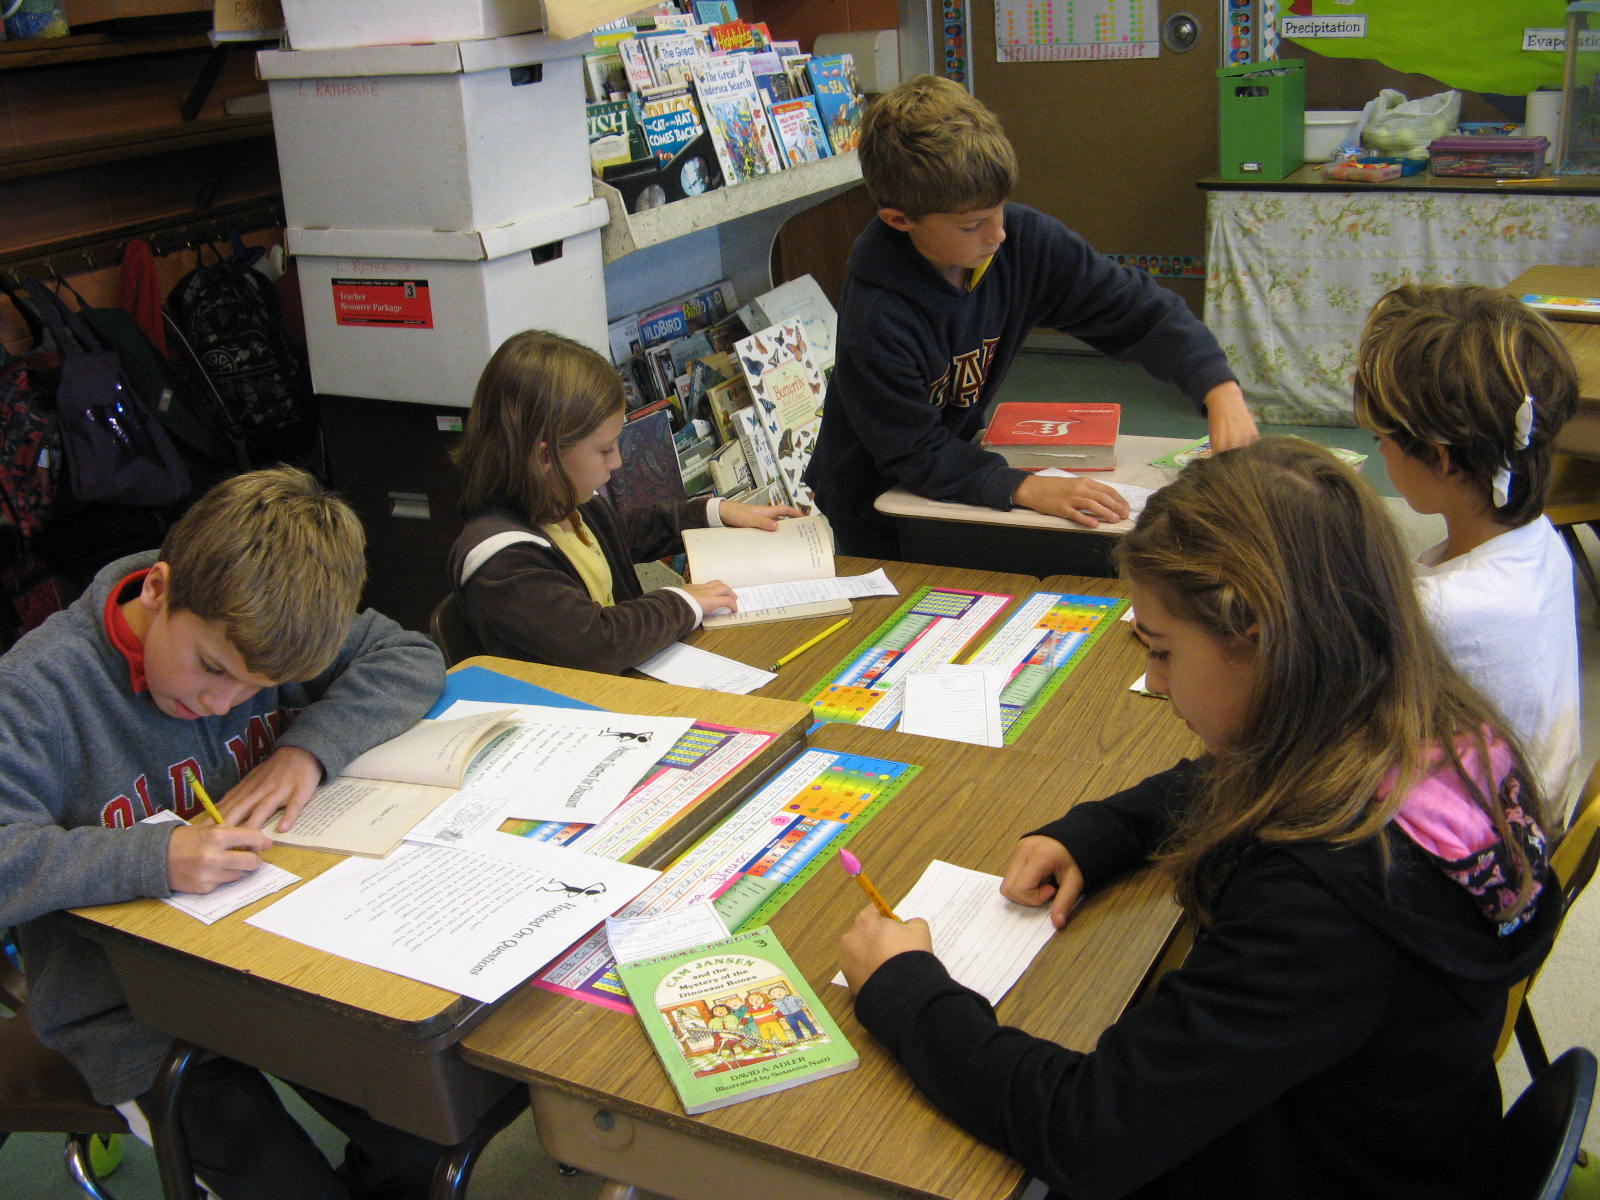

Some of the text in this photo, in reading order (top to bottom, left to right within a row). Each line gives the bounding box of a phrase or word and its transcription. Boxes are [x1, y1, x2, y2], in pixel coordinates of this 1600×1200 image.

[1285, 21, 1361, 36] Precipitation
[1528, 34, 1600, 49] Evapatio
[674, 46, 696, 58] Great
[705, 68, 737, 83] The Great
[728, 79, 752, 91] Search
[652, 118, 667, 132] CAT
[675, 112, 692, 125] HAT
[649, 131, 675, 146] COMES
[340, 292, 367, 301] Teacher
[407, 285, 415, 297] 3
[340, 302, 403, 313] Resource Package
[469, 902, 577, 976] Hooked On Questions
[754, 939, 768, 948] 3
[666, 957, 756, 988] CAM JANSEN
[679, 977, 719, 991] Mystery
[733, 969, 749, 977] the
[692, 967, 728, 980] and the
[679, 975, 758, 999] Dinosaur Bones
[730, 1069, 761, 1082] DAVID
[772, 1056, 807, 1070] ADLER
[715, 1077, 761, 1093] Illustrated
[760, 1073, 770, 1081] by
[771, 1064, 808, 1078] Susanna
